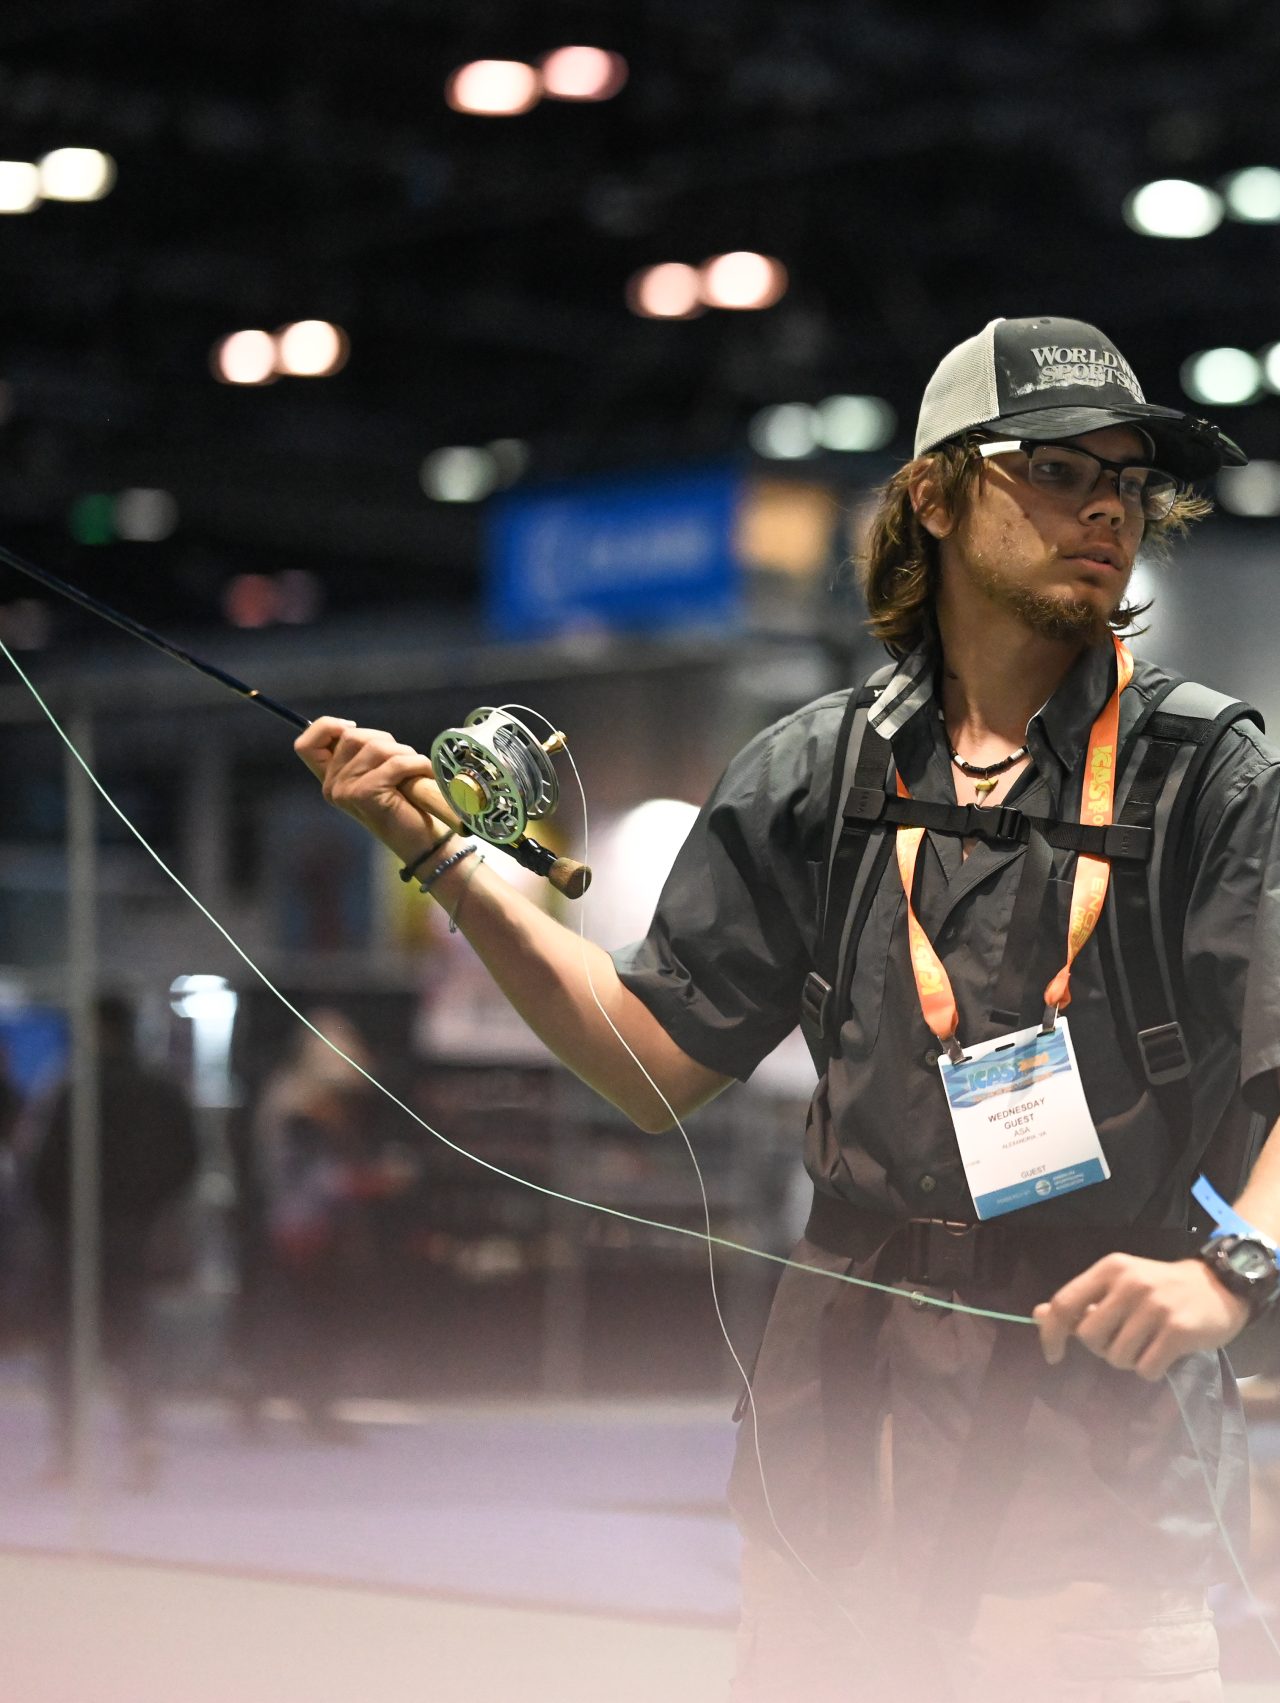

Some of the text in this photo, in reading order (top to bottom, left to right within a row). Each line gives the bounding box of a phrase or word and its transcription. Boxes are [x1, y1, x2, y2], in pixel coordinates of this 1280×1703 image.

[1031, 346, 1118, 368] WORLD
[987, 1097, 1045, 1123] WEDNESDAY
[1004, 1112, 1034, 1130] GUEST
[1020, 1164, 1046, 1180] GUEST
